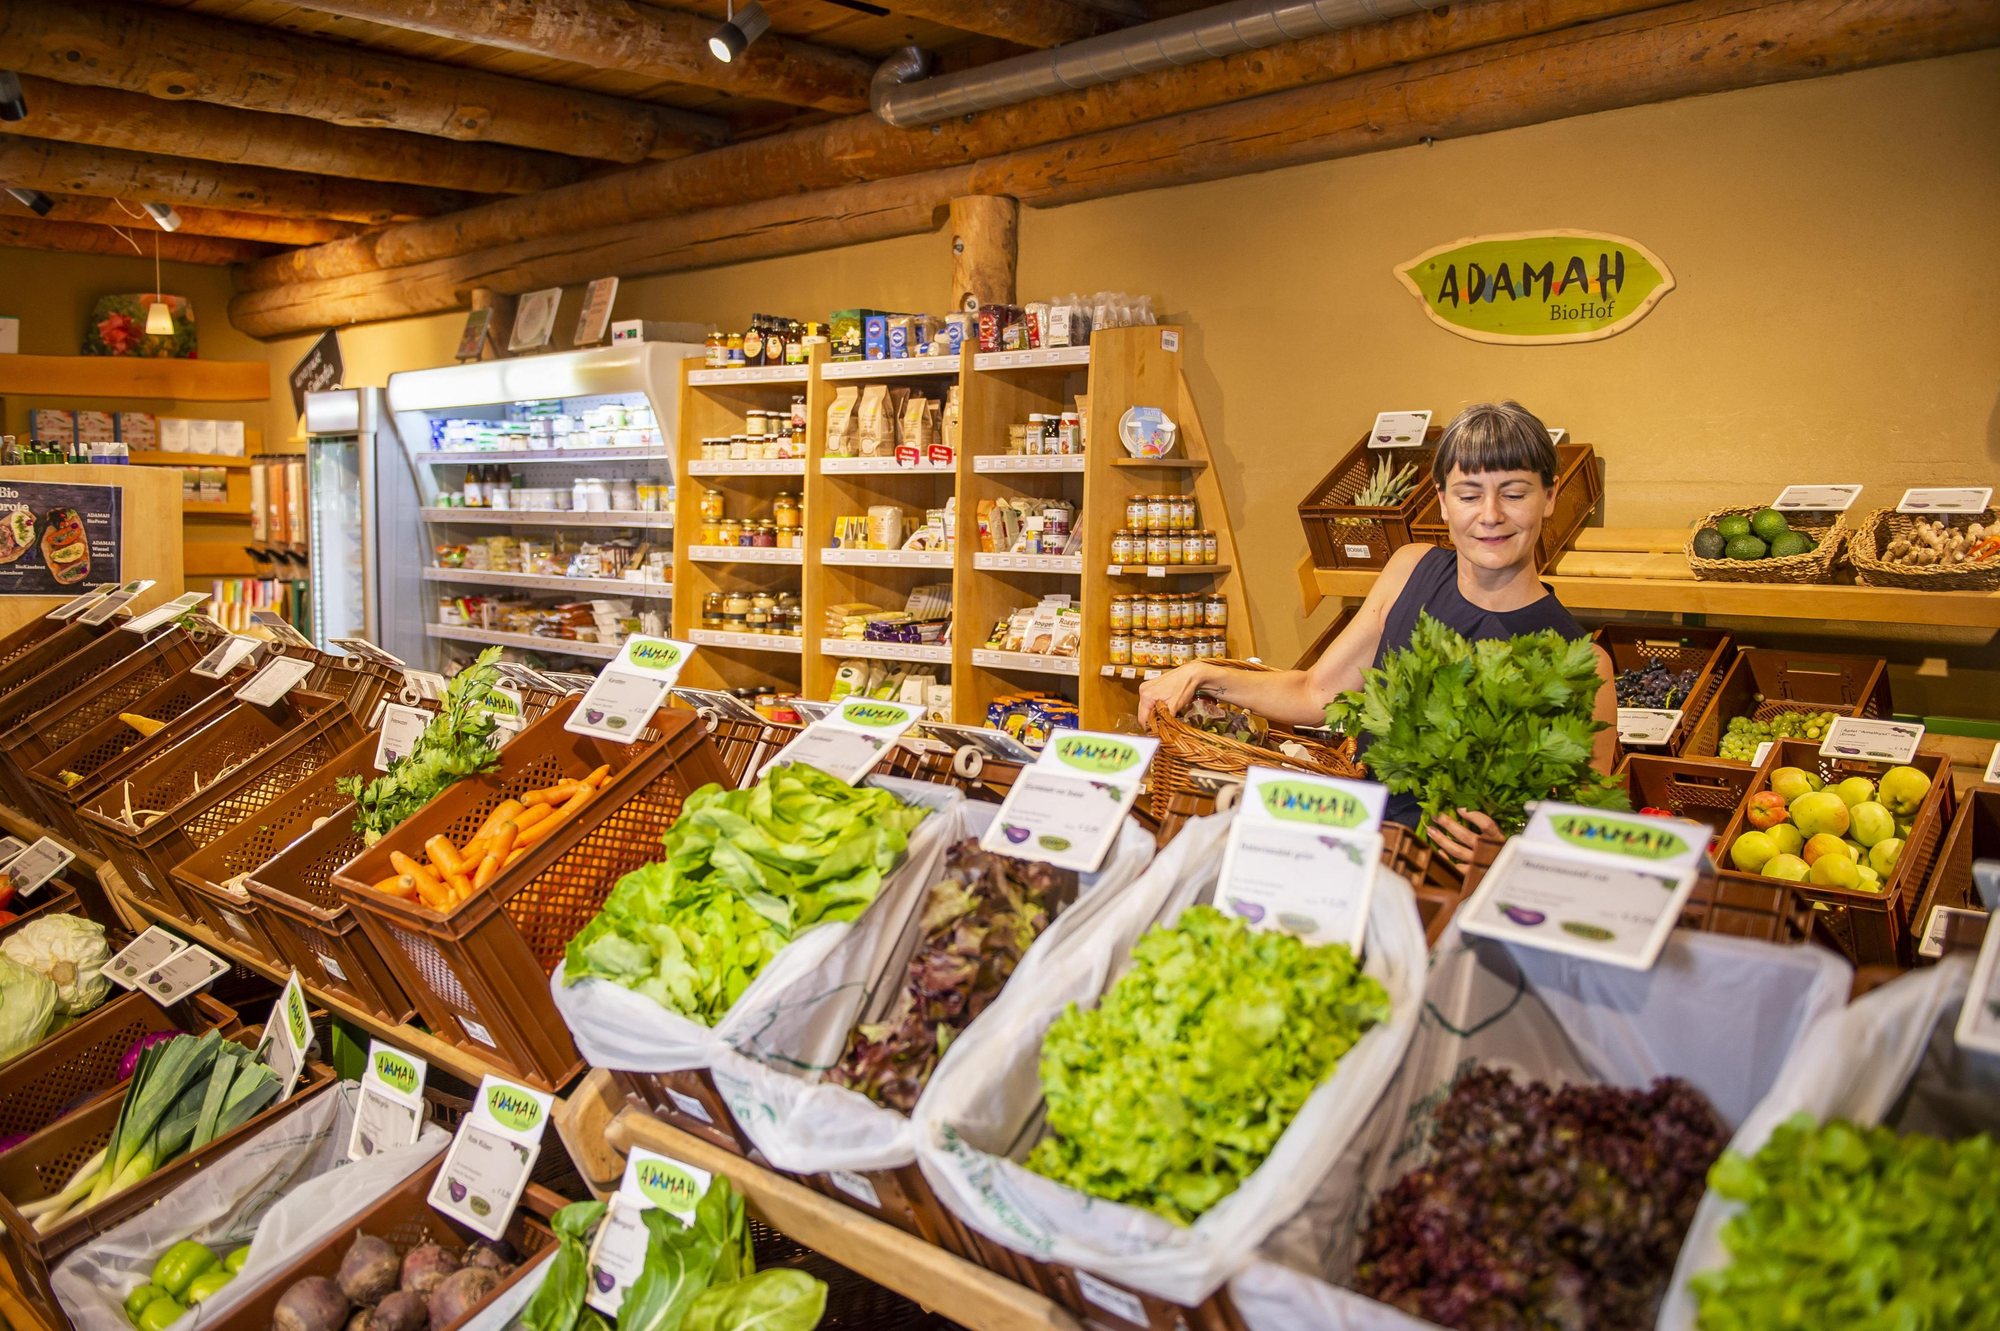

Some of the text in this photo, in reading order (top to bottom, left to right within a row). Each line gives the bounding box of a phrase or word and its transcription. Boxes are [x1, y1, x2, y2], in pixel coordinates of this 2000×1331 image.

[1437, 250, 1625, 309] ADAMAH
[1549, 300, 1616, 321] BioHof
[0, 486, 19, 498] Bio
[633, 644, 678, 661] ADAMAH
[847, 706, 905, 721] ADAMAH
[1062, 741, 1132, 761] ADAMAH
[1269, 787, 1357, 815] ADAMAH
[1557, 818, 1675, 849] ADAMAH
[378, 1056, 415, 1083] ADAMAH
[491, 1090, 538, 1120] ADAMAH
[640, 1164, 696, 1198] ADAMAH
